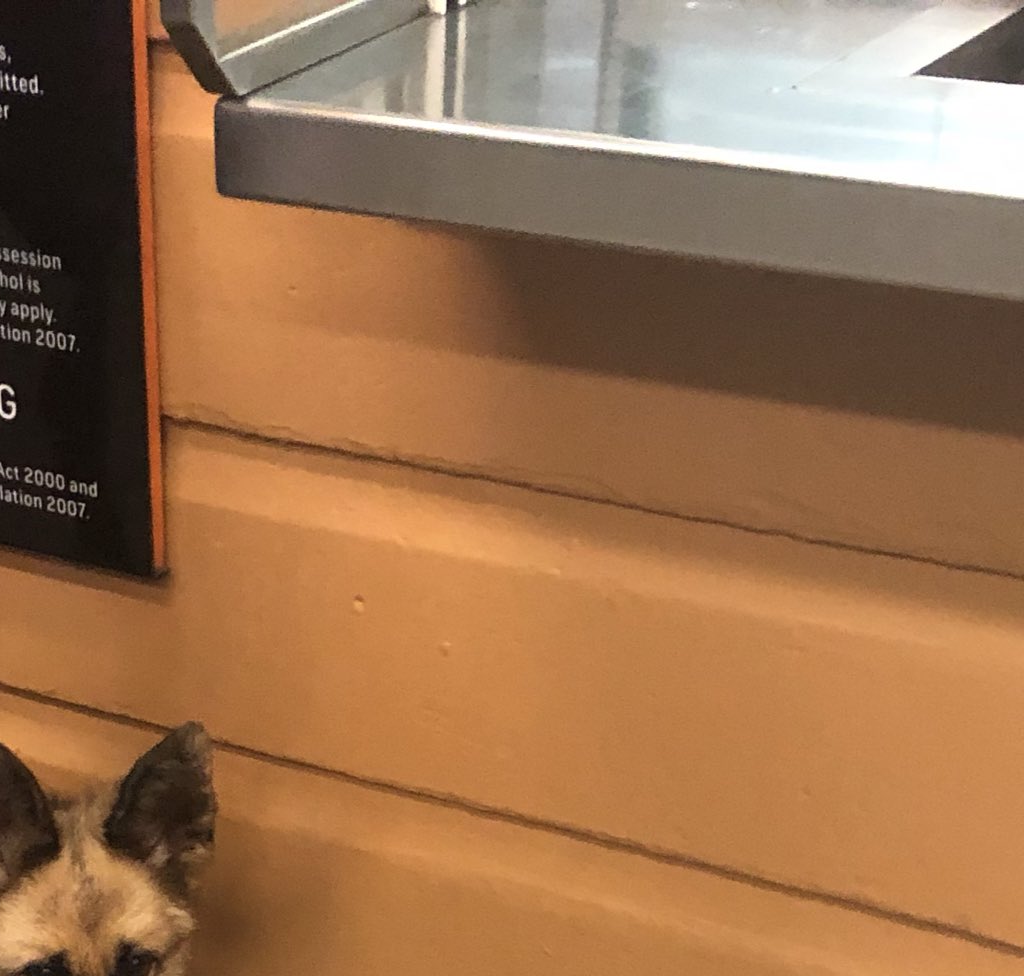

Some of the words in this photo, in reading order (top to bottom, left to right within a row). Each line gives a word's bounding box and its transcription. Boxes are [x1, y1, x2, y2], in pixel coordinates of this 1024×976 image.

[27, 274, 41, 294] is
[10, 300, 57, 326] apply.
[36, 328, 80, 353] 2007.
[24, 467, 66, 492] 2000
[69, 479, 99, 498] and
[46, 495, 91, 520] 2007.
